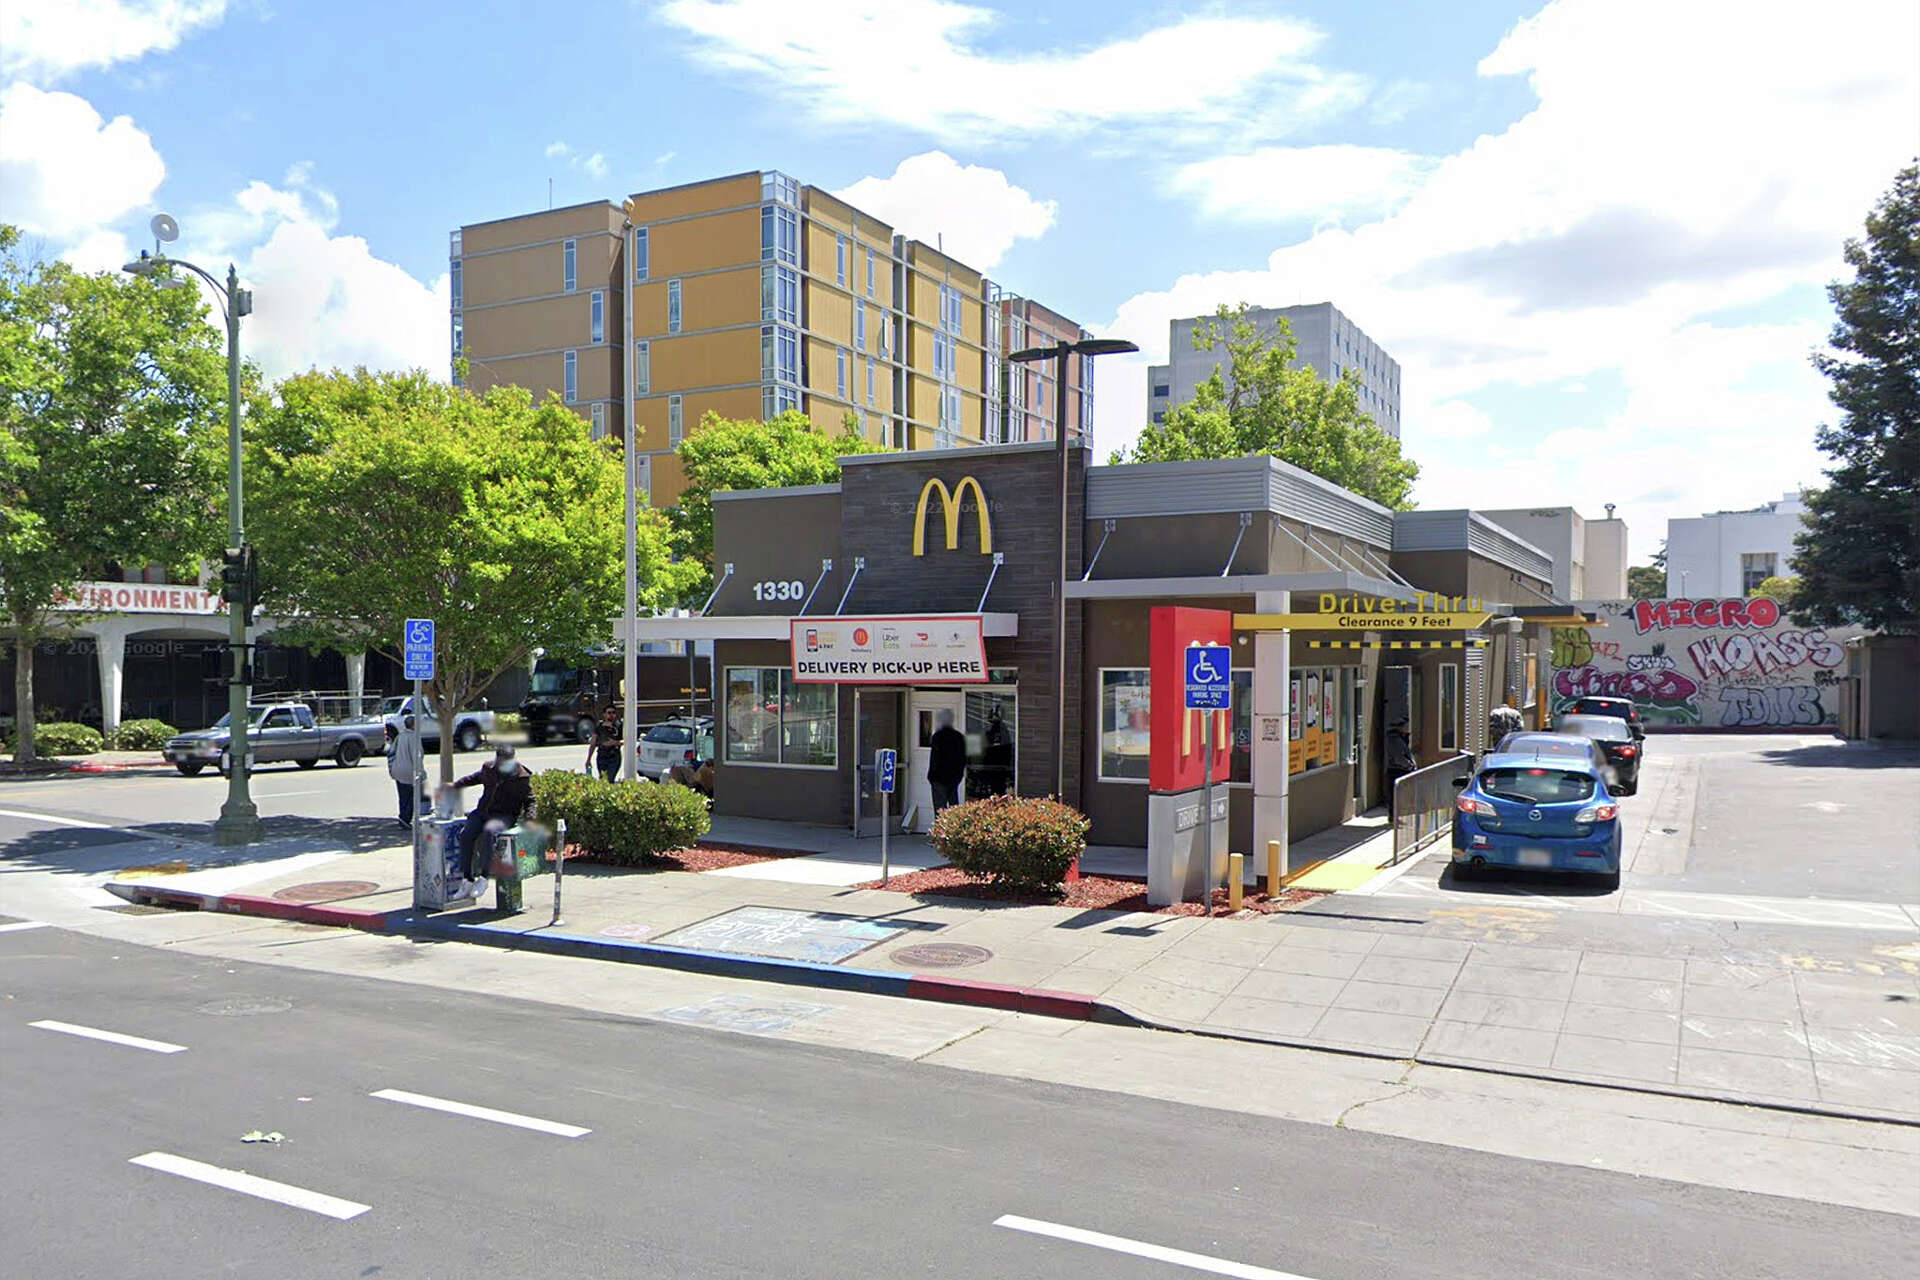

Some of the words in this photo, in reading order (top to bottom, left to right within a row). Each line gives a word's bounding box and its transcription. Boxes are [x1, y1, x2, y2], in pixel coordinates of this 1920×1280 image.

[753, 581, 804, 600] 1330
[1319, 592, 1484, 613] Drive-Thru
[1338, 616, 1405, 627] Clearance
[1409, 616, 1418, 627] 9
[1422, 616, 1451, 627] Feet
[1633, 597, 1780, 636] MICRO
[798, 661, 868, 674] DELIVERY
[873, 661, 933, 674] PICK-UP
[937, 661, 981, 673] HERE
